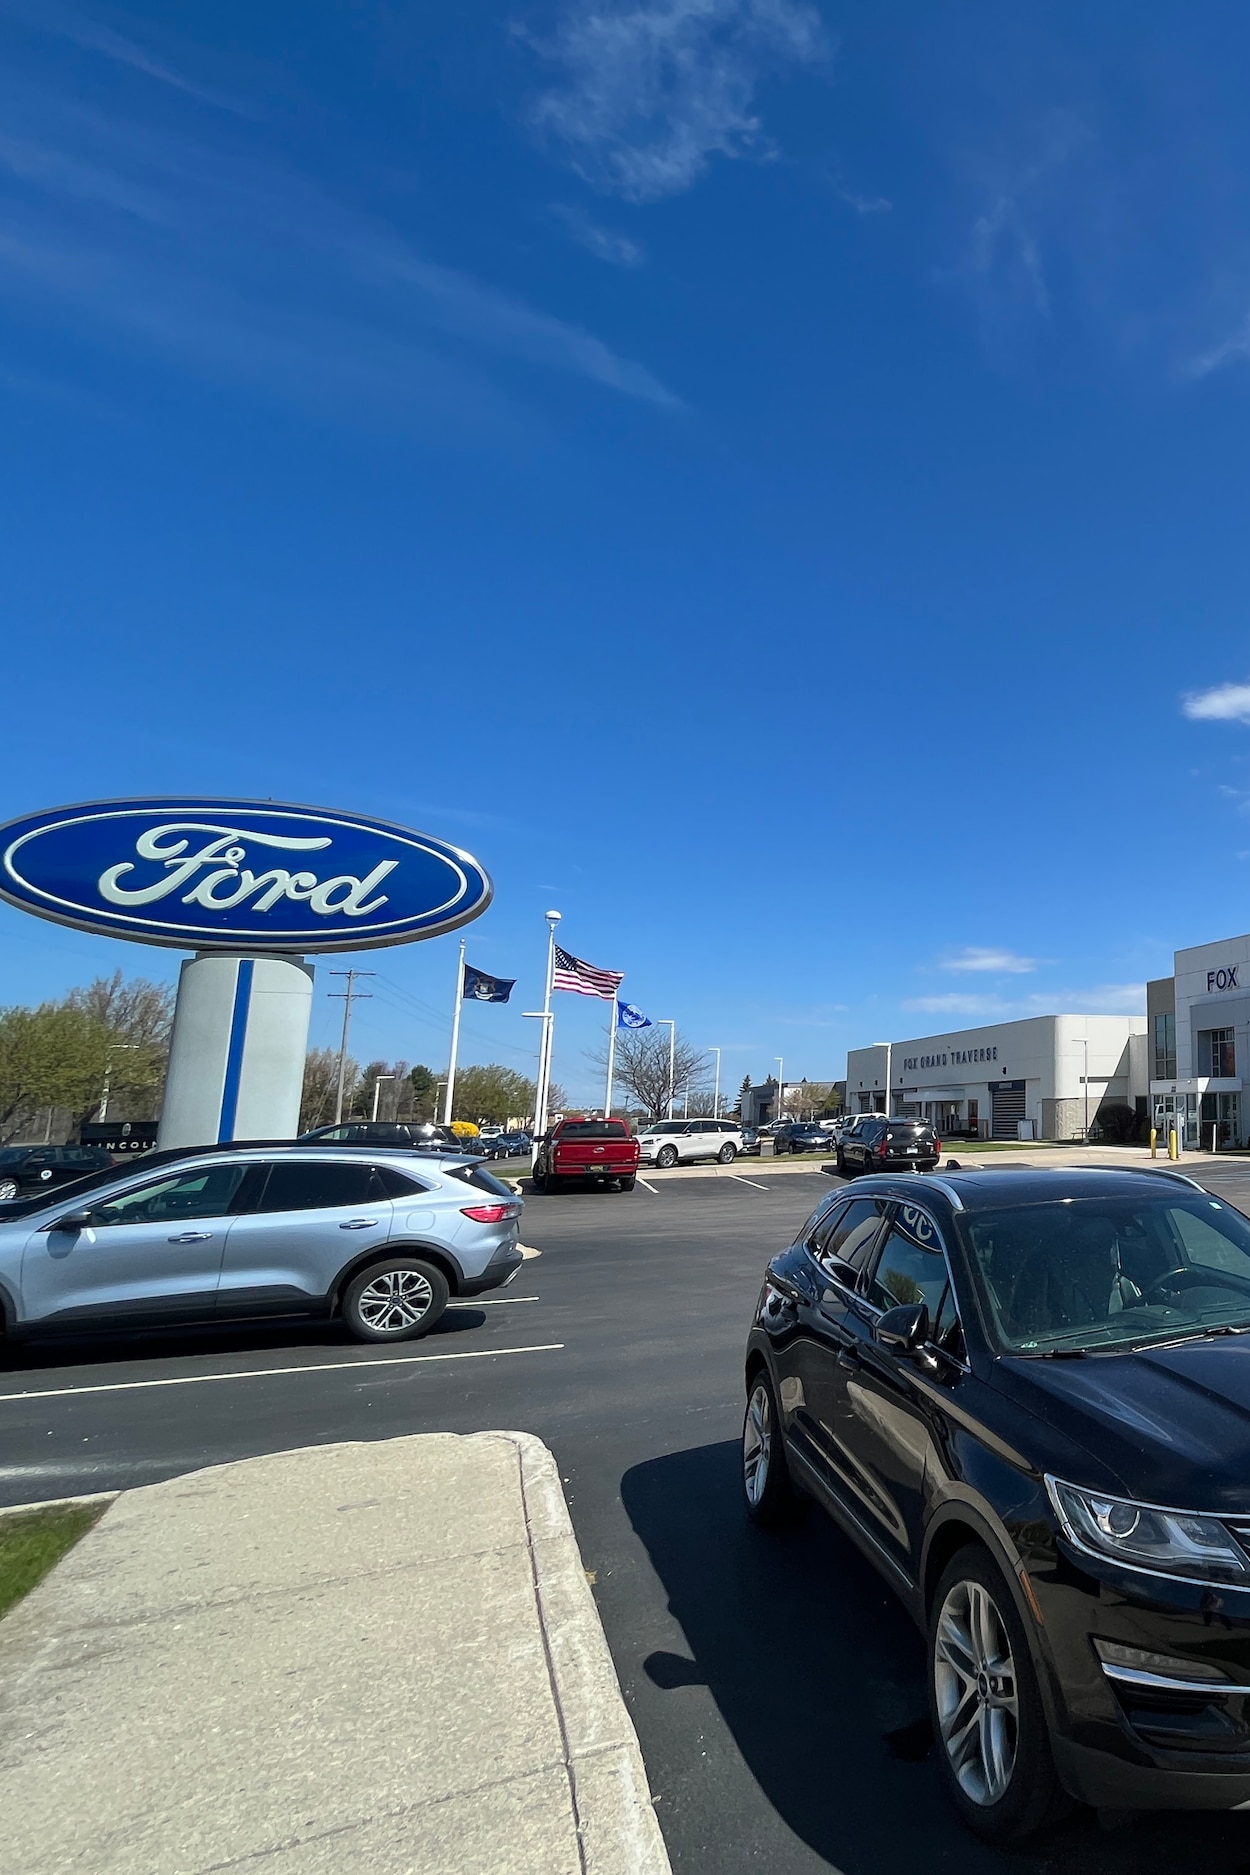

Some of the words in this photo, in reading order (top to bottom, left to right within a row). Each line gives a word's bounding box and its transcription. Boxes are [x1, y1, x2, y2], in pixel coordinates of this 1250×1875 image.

[97, 822, 400, 917] Ford
[1207, 966, 1239, 992] FOX
[903, 1056, 919, 1072] FOX
[920, 1053, 948, 1069] GRAND
[950, 1046, 999, 1066] TRAVERSE
